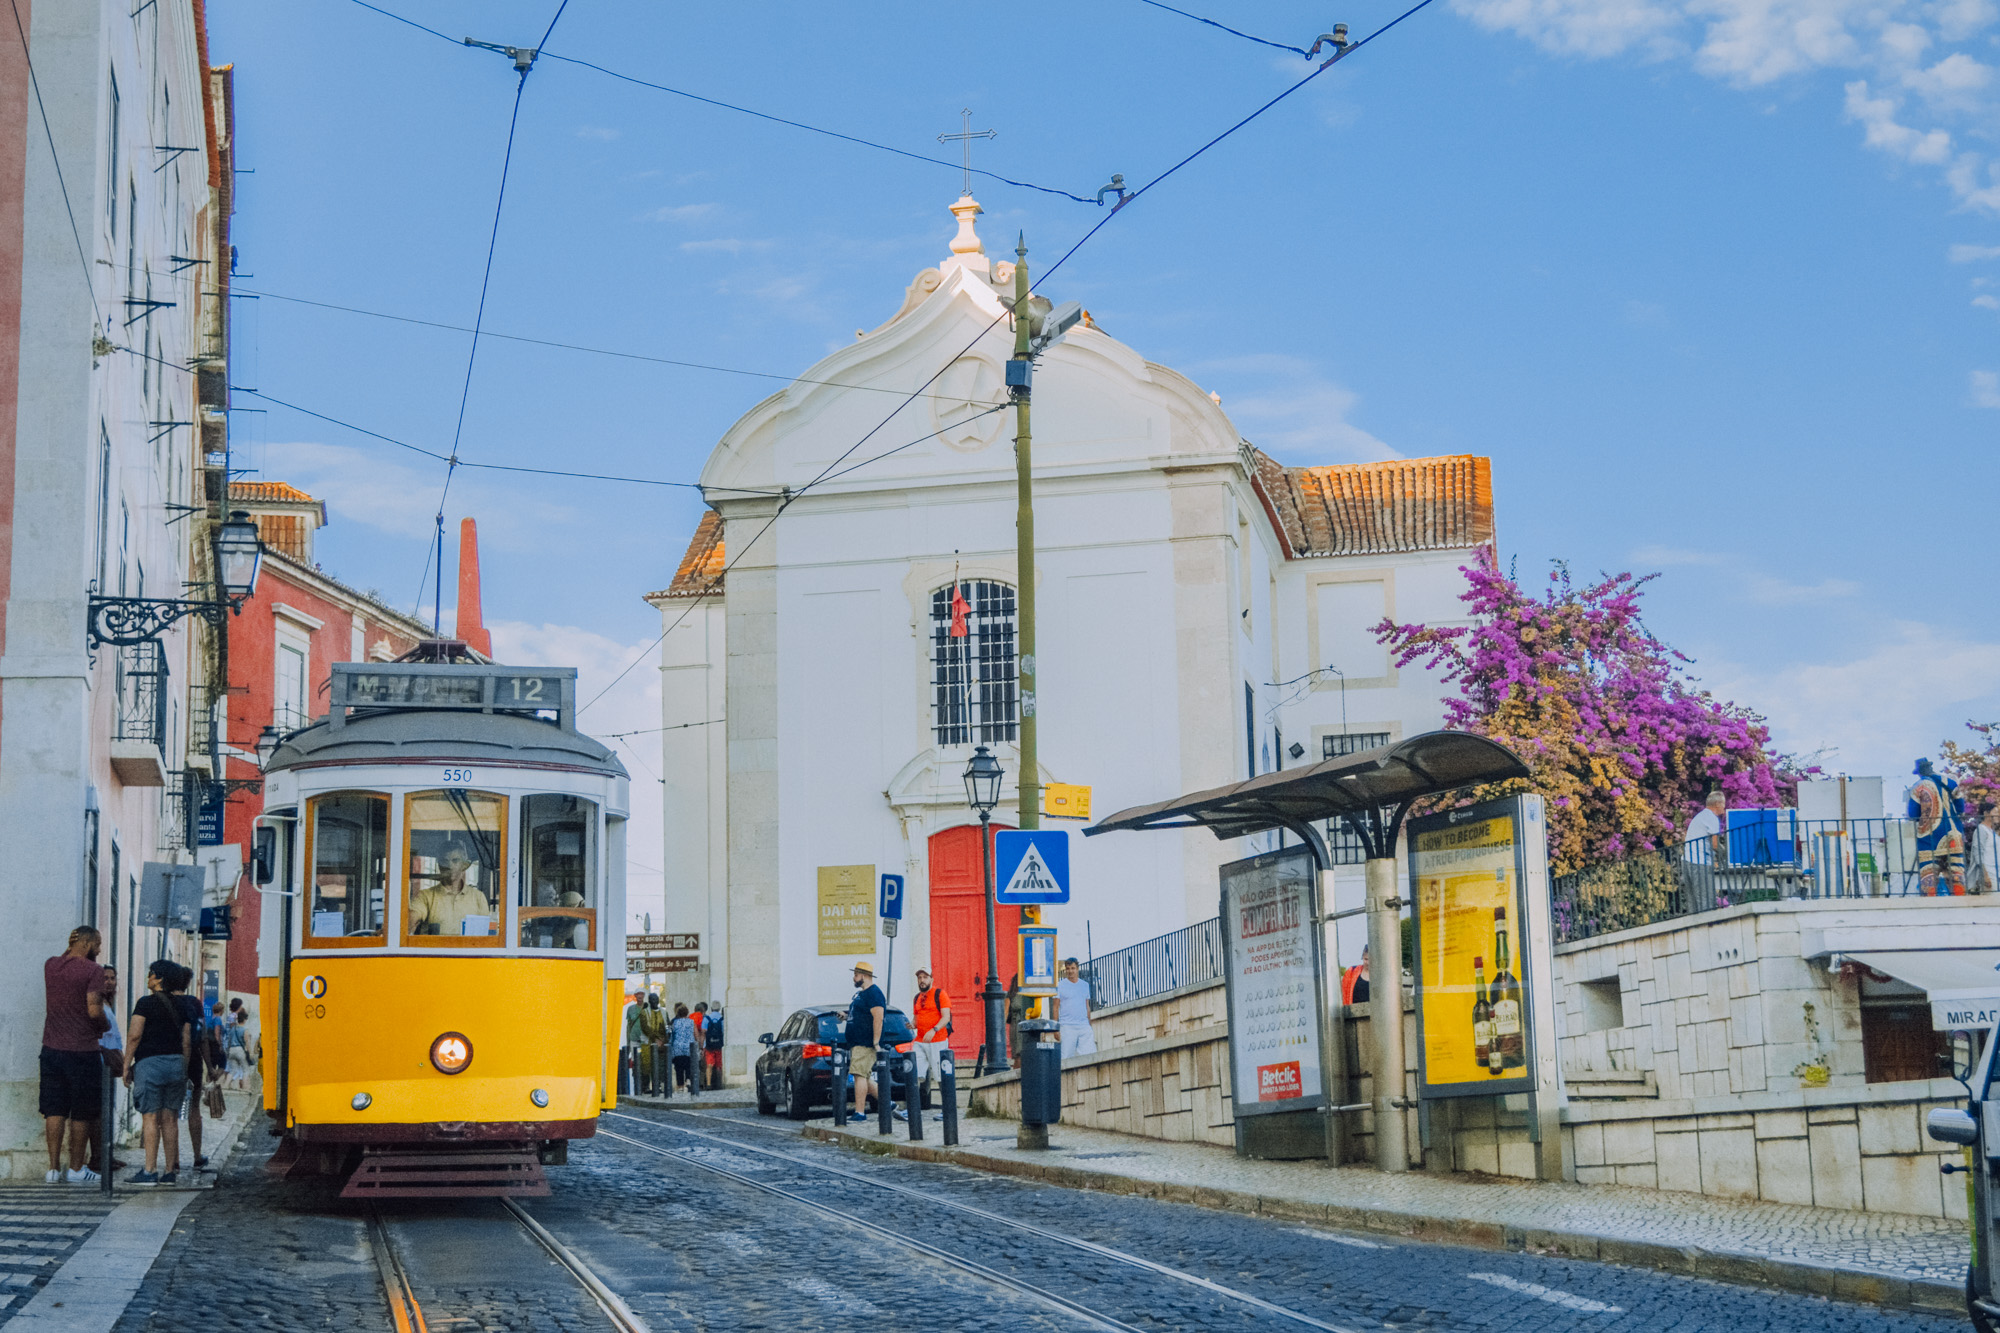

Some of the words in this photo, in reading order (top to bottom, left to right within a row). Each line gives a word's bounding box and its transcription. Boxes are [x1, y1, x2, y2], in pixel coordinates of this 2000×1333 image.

[510, 678, 543, 701] 12
[443, 769, 472, 782] 550
[199, 813, 217, 822] arol
[199, 831, 217, 839] uzia
[1423, 837, 1442, 850] HOW
[1445, 833, 1456, 845] TO
[1457, 824, 1491, 843] BECOME
[1455, 838, 1511, 862] PORTUGUESE
[884, 878, 898, 913] P
[645, 960, 665, 968] castelo
[1262, 1065, 1296, 1087] Betclic
